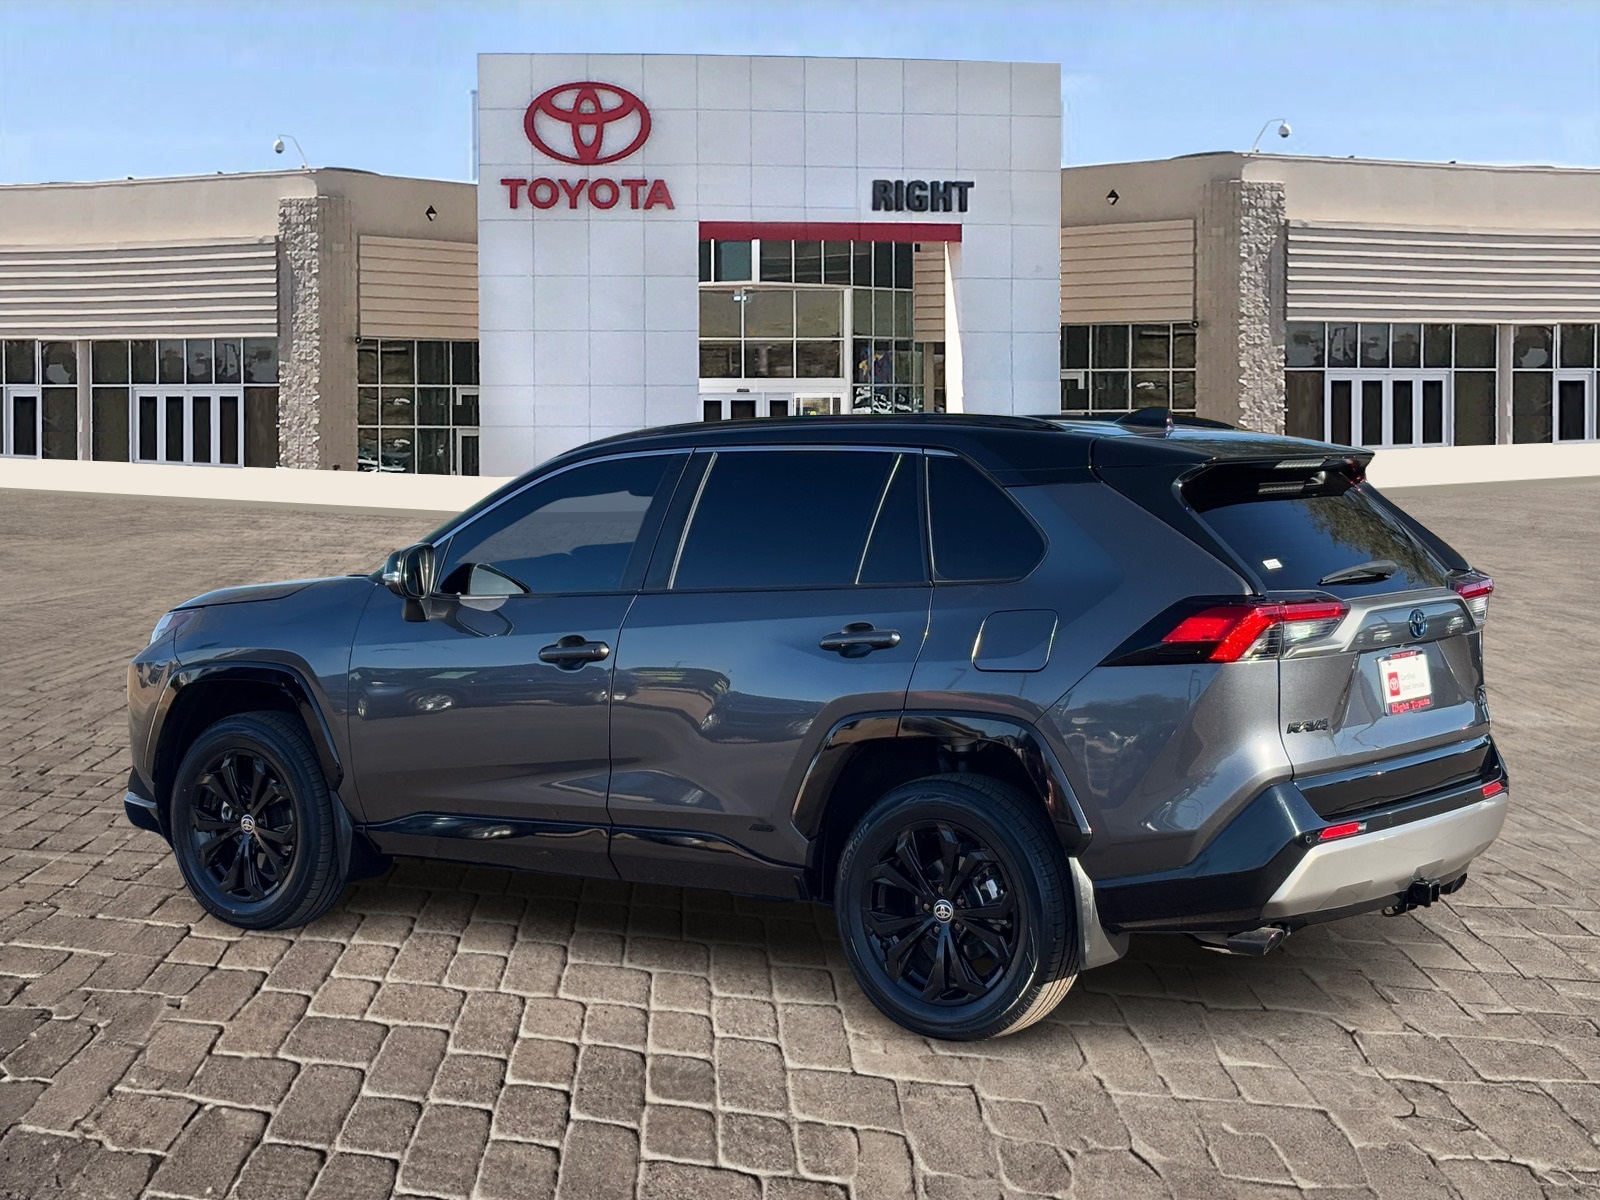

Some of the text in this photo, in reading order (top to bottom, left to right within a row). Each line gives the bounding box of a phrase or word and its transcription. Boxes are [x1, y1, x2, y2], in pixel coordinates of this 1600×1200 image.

[500, 177, 675, 210] TOYOTA
[871, 179, 975, 212] RIGHT
[1410, 698, 1431, 710] Toyota
[1286, 717, 1329, 734] RAV4
